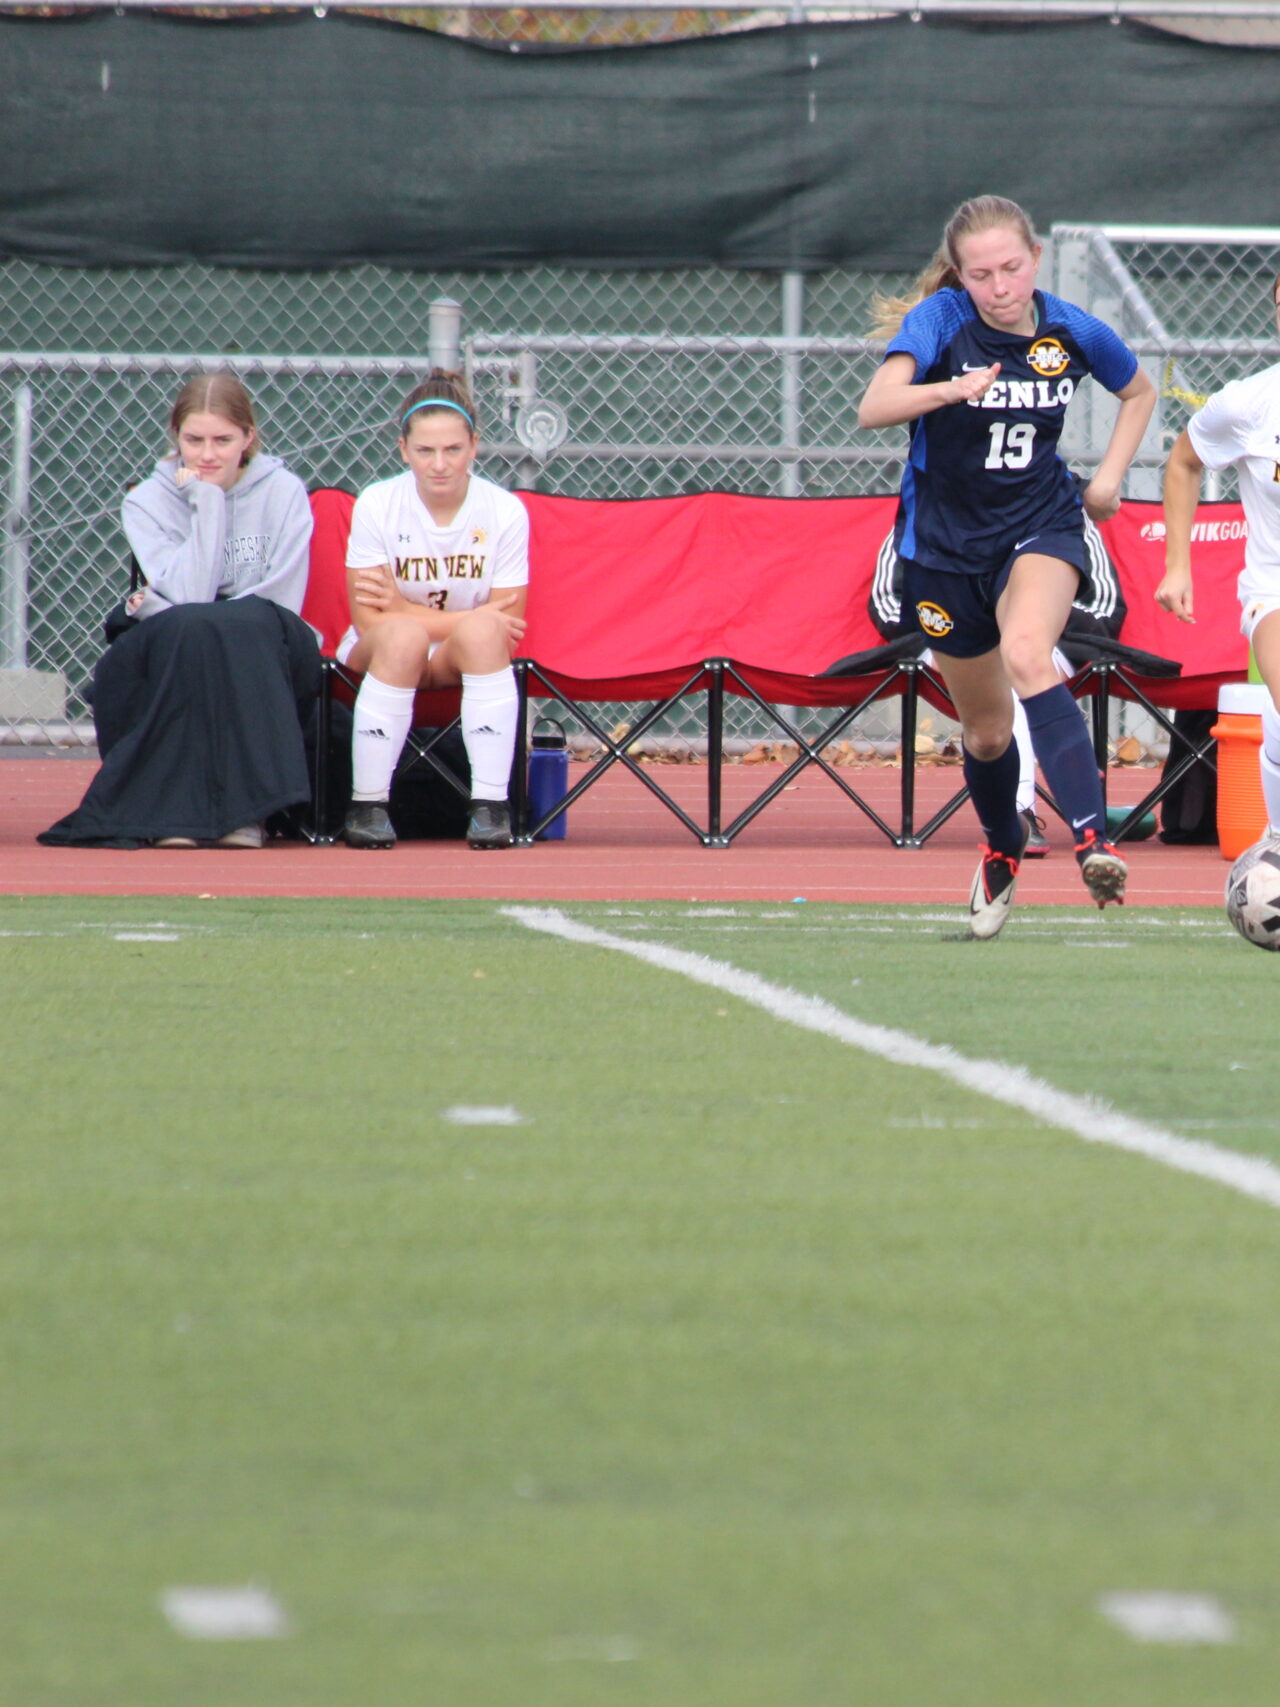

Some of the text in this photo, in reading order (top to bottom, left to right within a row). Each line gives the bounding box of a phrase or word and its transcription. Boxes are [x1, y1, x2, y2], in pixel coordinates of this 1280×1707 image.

[951, 376, 1075, 407] ENLO
[984, 421, 1038, 470] 19
[394, 555, 438, 582] MTN
[427, 589, 449, 611] 3
